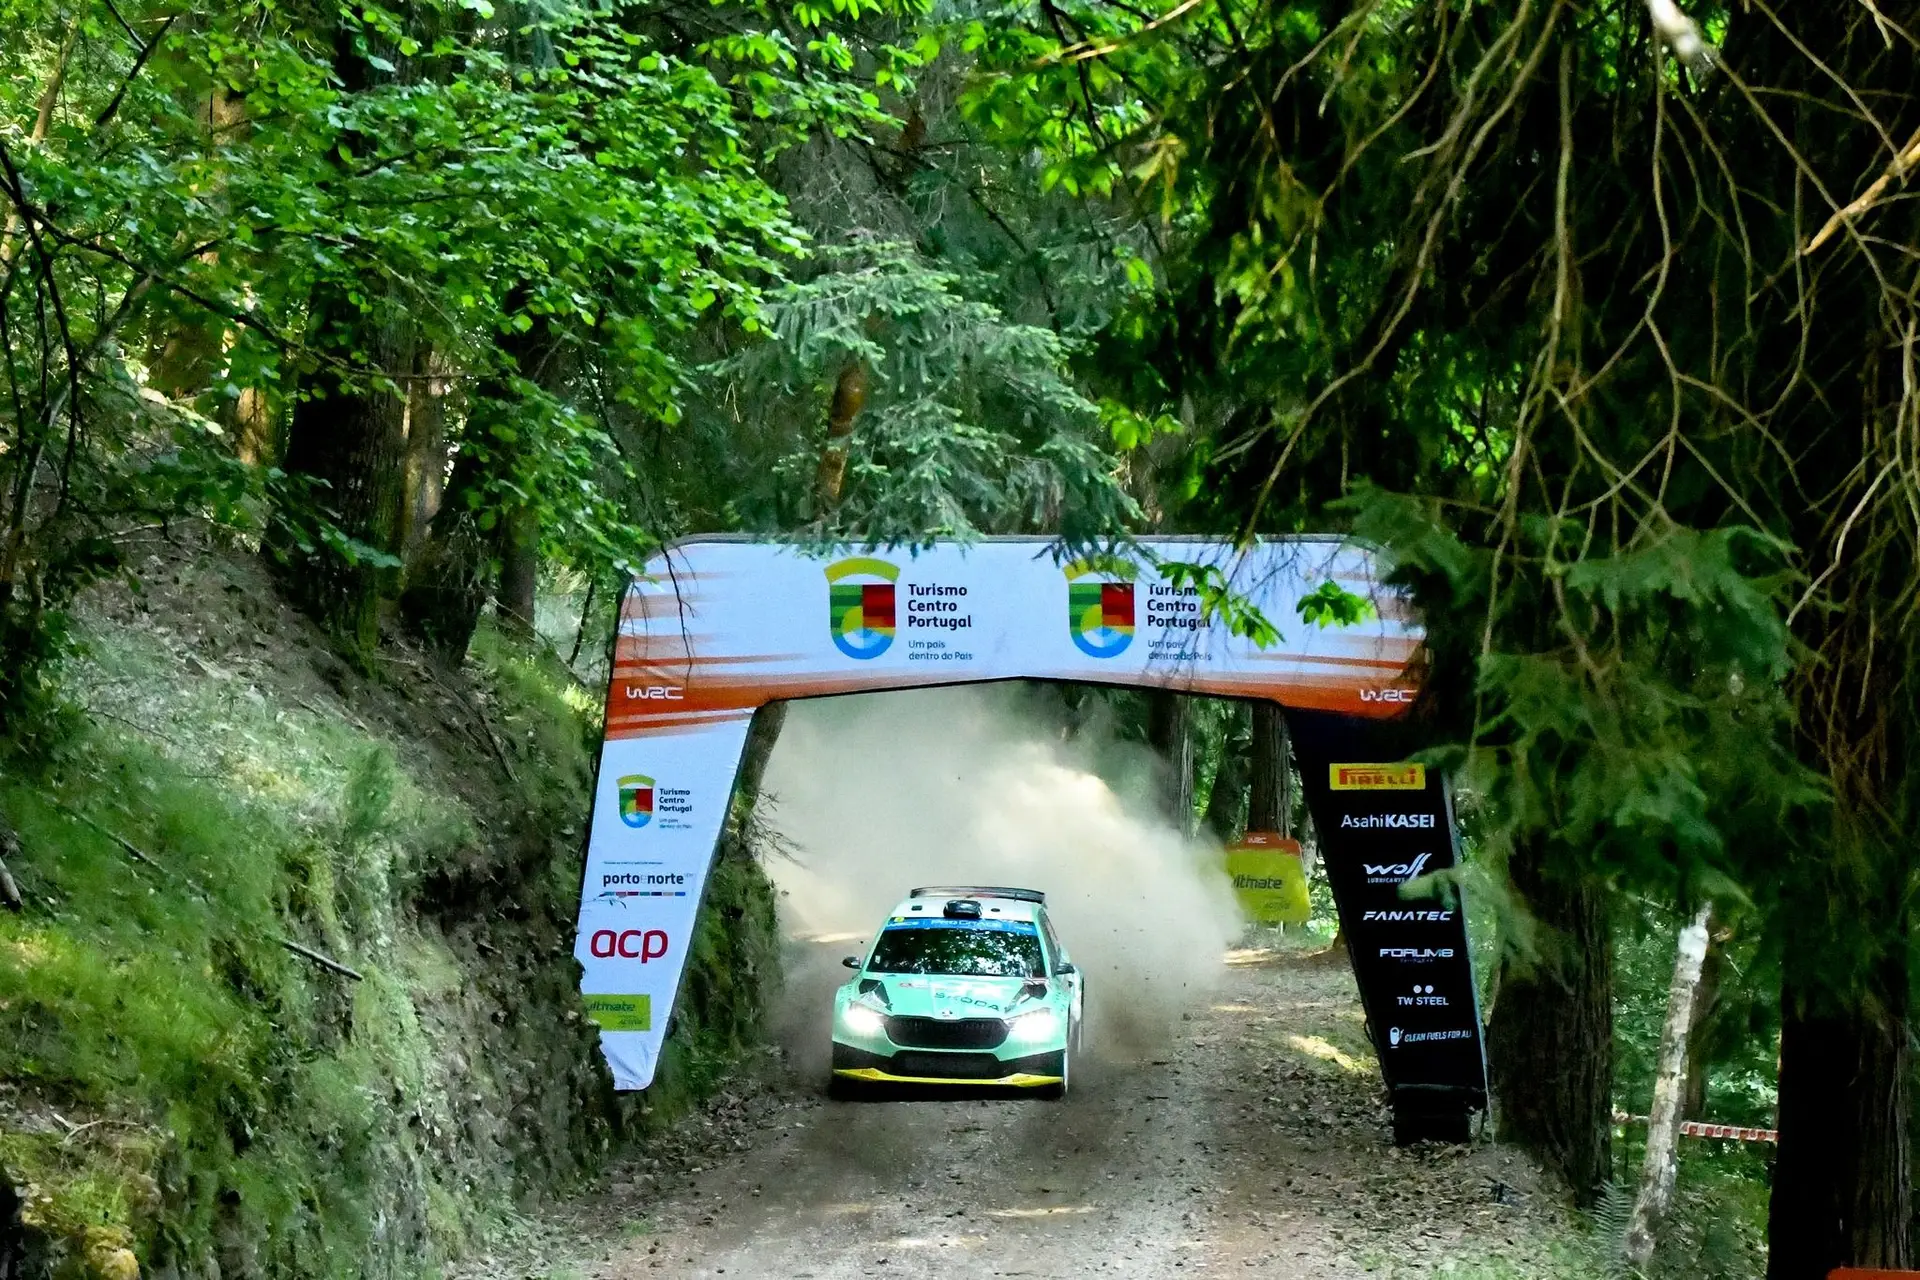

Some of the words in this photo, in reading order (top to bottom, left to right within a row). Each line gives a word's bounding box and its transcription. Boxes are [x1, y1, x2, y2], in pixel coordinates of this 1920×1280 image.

[908, 583, 967, 596] Turismo
[1148, 583, 1199, 596] Turism
[908, 599, 957, 612] Centro
[1147, 599, 1197, 612] Centro
[908, 615, 972, 631] Portugal
[908, 640, 925, 649] Um
[1147, 640, 1164, 648] Um
[908, 652, 940, 660] dentro
[941, 652, 953, 660] do
[626, 686, 684, 699] WRC
[1360, 689, 1417, 702] WRC
[1339, 768, 1417, 785] PIRELLI
[659, 788, 691, 796] Turismo
[659, 805, 693, 813] Portugal
[1363, 911, 1454, 921] FANATEC
[590, 930, 668, 964] acp
[1397, 997, 1414, 1006] TW
[1416, 997, 1450, 1006] STEEL
[1404, 1033, 1426, 1043] CLEAN
[1426, 1031, 1447, 1041] FUELS
[1447, 1030, 1461, 1039] FOR
